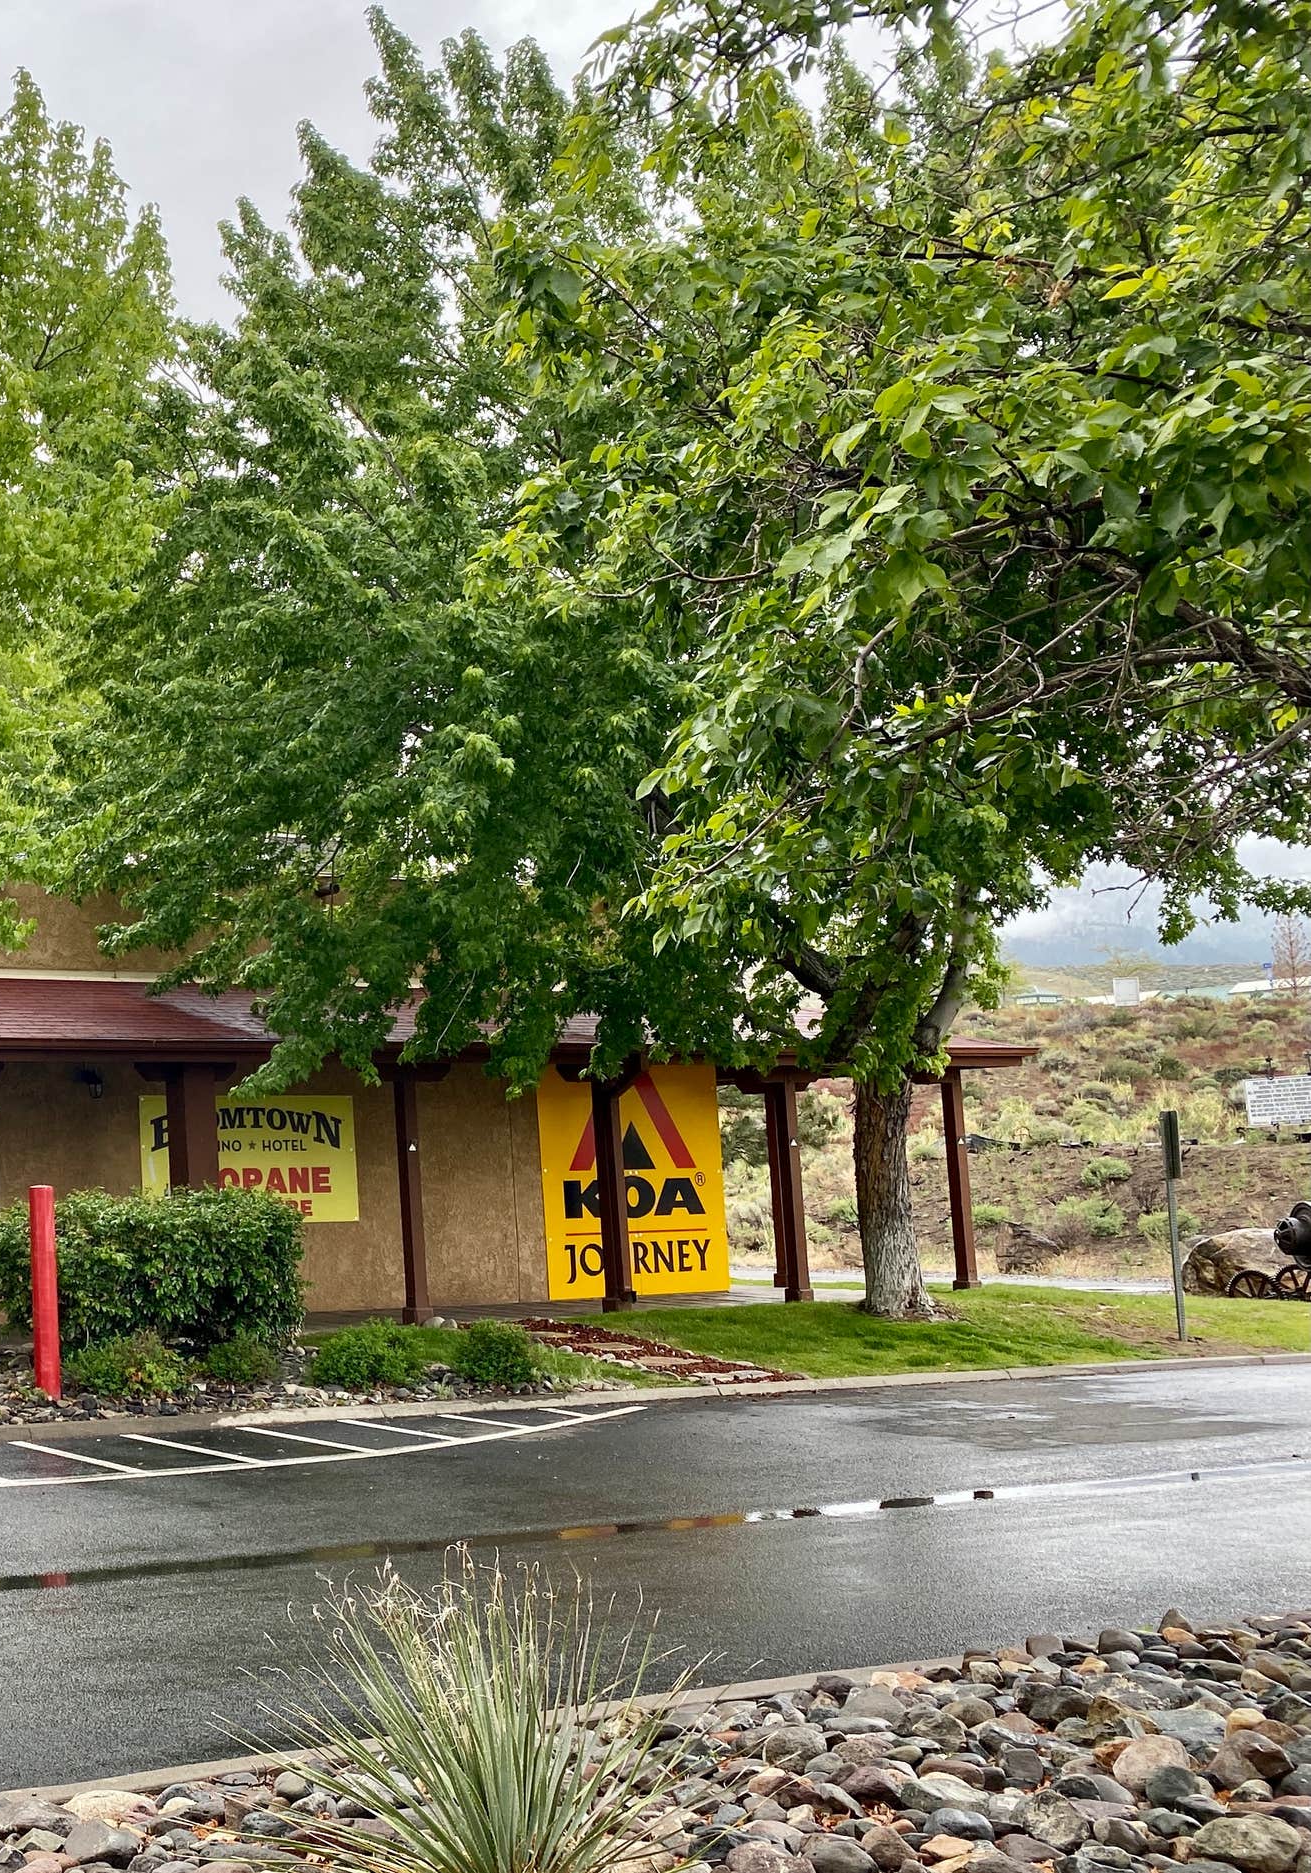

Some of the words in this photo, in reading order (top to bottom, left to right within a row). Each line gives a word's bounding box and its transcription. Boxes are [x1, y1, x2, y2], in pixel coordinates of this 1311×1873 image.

[151, 1107, 342, 1151] BMTOWN
[262, 1140, 307, 1151] HOTEL
[219, 1167, 331, 1193] OPANE
[563, 1176, 706, 1219] KOA
[564, 1239, 711, 1284] JORNEY
